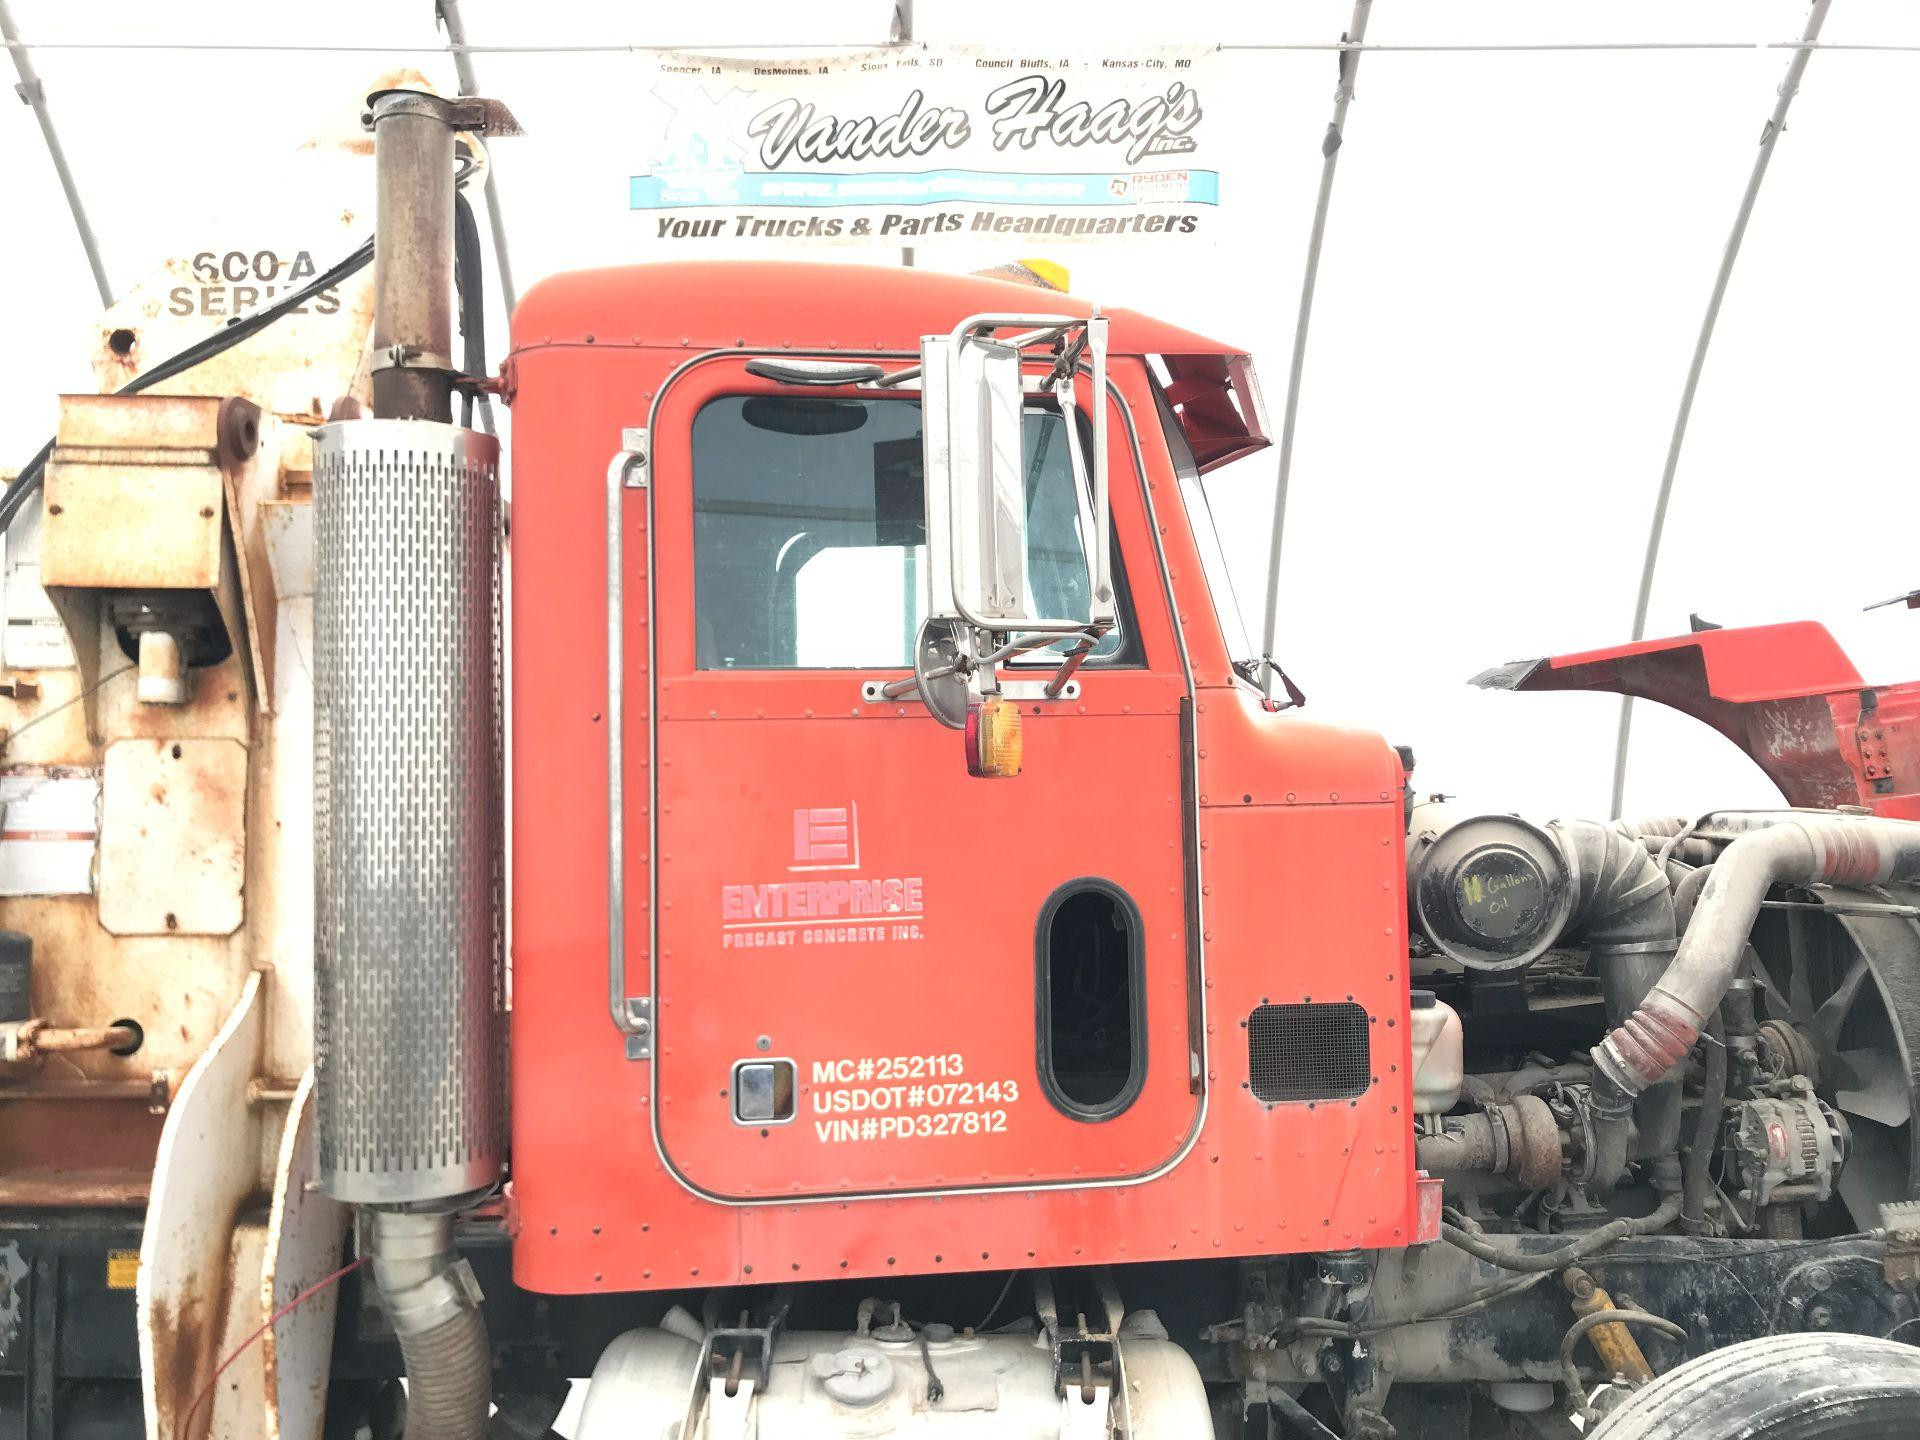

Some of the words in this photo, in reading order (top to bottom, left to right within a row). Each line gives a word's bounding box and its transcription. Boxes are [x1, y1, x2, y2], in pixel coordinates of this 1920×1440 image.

[659, 64, 704, 75] Spencer,
[711, 66, 722, 75] IA
[818, 66, 829, 75] IA
[860, 62, 889, 72] Sioux
[929, 58, 943, 67] SD
[975, 58, 1013, 69] Council
[1020, 58, 1052, 70] Bluffs,
[1059, 59, 1069, 68] IA
[1102, 59, 1139, 69] Kansas
[1145, 59, 1168, 70] City,
[1174, 59, 1192, 69] MO
[747, 89, 972, 171] Vander
[984, 74, 1203, 166] Haag's
[657, 217, 727, 239] Your
[735, 215, 844, 237] Trucks
[849, 217, 872, 236] &
[879, 213, 965, 236] Parts
[970, 211, 1199, 236] Headquarters
[169, 285, 342, 317] SERS
[722, 876, 924, 921] ENTERPRISE
[1487, 873, 1534, 894] Gallons
[1489, 896, 1510, 914] Oil
[722, 930, 797, 949] PRECAST
[802, 926, 886, 945] CONCRETE
[891, 924, 925, 940] INC.
[812, 1053, 965, 1085] MC#252113
[813, 1080, 1020, 1115] USDOT#072143
[814, 1109, 1008, 1144] VIN#PD327812
